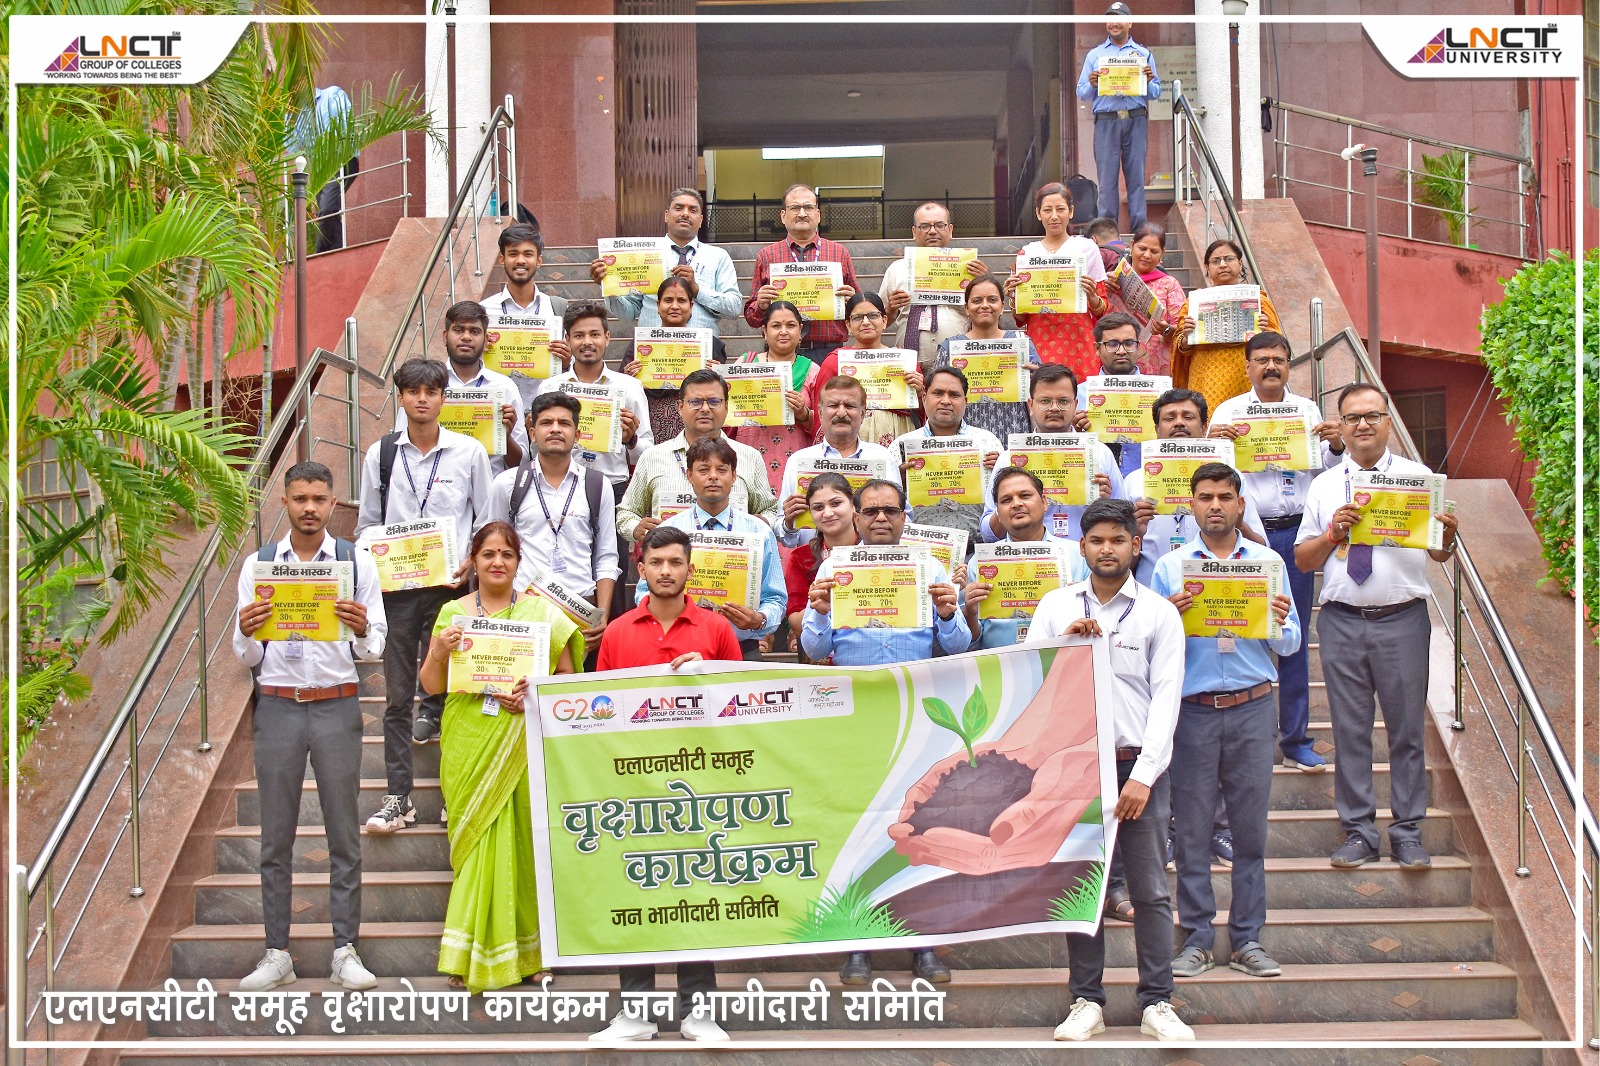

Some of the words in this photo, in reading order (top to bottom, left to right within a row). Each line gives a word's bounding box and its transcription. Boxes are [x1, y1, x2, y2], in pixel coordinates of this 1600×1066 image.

[498, 316, 519, 326] दैनिक
[521, 318, 545, 326] भास्कर
[650, 329, 671, 338] दैनिक
[965, 341, 986, 350] दैनिक
[854, 351, 876, 359] दैनिक
[728, 366, 750, 374] दैनिक
[1104, 378, 1127, 387] दैनिक
[445, 390, 461, 399] निक
[559, 384, 581, 394] दैनिक
[583, 388, 608, 396] भास्कर
[1247, 406, 1270, 415] दैनिक
[1272, 406, 1298, 414] भास्कर
[922, 439, 945, 449] दैनिक
[1026, 436, 1050, 446] दैनिक
[1051, 438, 1079, 446] भास्कर
[1160, 443, 1186, 453] दैनिक
[1187, 445, 1215, 453] भास्कर
[814, 460, 839, 470] दैनिक
[840, 463, 867, 471] भास्कर
[1370, 475, 1394, 485] दैनिक
[1396, 477, 1424, 486] भास्कर
[386, 525, 408, 535] दैनिक
[409, 522, 436, 531] भास्कर
[902, 526, 918, 537] निक
[920, 529, 949, 540] भास्कर
[714, 537, 744, 546] भास्कर
[850, 551, 877, 562] दैनिक
[995, 546, 1021, 556] दैनिक
[1022, 546, 1050, 555] भास्कर
[272, 565, 298, 575] दैनिक
[300, 568, 332, 576] भास्कर
[1202, 562, 1229, 573] दैनिक
[1230, 565, 1261, 573] भास्कर
[547, 582, 569, 602] दैनिक
[568, 596, 592, 618] भास्कर
[472, 619, 498, 631] दैनिक
[500, 622, 530, 633] भास्कर
[648, 696, 703, 709] LNCT
[736, 690, 796, 707] LNCT
[553, 695, 617, 721] G20
[737, 704, 792, 716] UNIVERSITY
[614, 746, 706, 775] एलएनसीटी
[711, 750, 754, 774] समूह
[561, 779, 791, 853] वृक्षारोपण
[623, 831, 818, 889] कार्यक्रम
[611, 907, 643, 926] जन
[648, 897, 720, 924] भागीदारी
[725, 894, 779, 920] समिति
